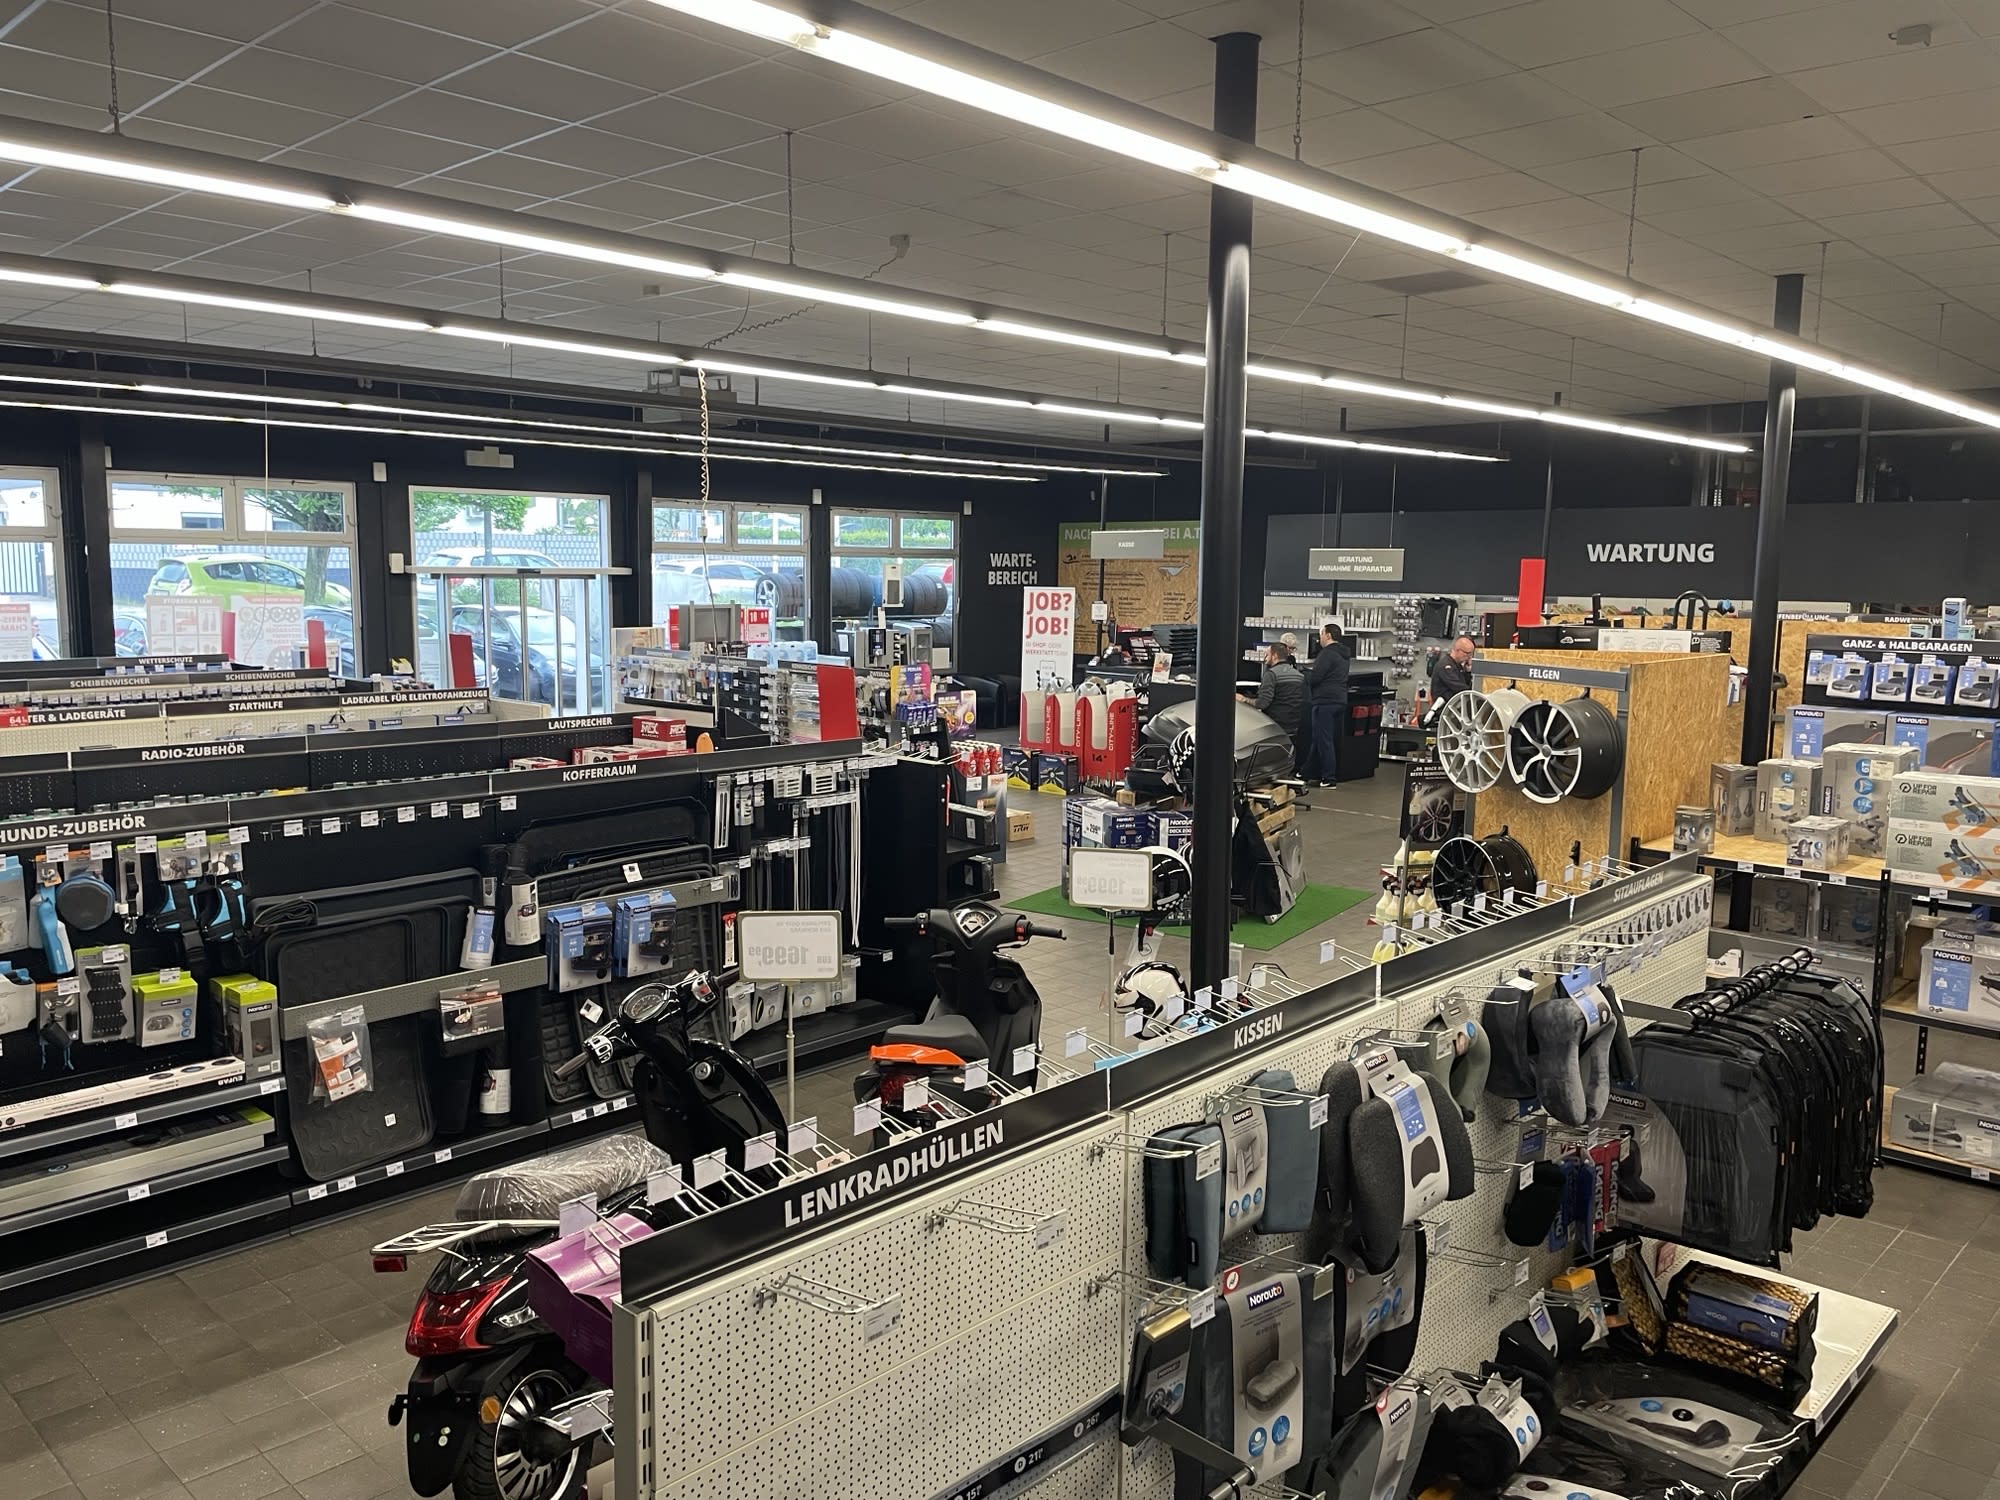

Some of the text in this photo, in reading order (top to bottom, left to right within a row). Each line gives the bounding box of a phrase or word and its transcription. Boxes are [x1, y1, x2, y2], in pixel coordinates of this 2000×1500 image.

[1587, 543, 1715, 563] WARTUNG
[990, 553, 1037, 568] WARTE-
[1354, 565, 1393, 573] REPARATUR
[988, 571, 1038, 585] BEREICH
[1026, 592, 1073, 615] JOB?
[1025, 616, 1069, 639] JOB!
[1842, 639, 1973, 652] GANZ- & HALBGARAGEN
[138, 656, 193, 665] WETTERSCHUTZ
[225, 671, 296, 681] SCHEIBENWISCHER
[1529, 668, 1560, 680] FELGEN
[70, 677, 150, 688] SCHEIBENWISCHER
[341, 690, 488, 705] LADEKABEL FÜR ELEKTROFAHRZEUGE
[228, 700, 284, 712] STARTHILFE
[48, 714, 57, 722] &
[60, 708, 126, 722] LADEGERÄTE
[1897, 717, 1928, 726] Norauto
[548, 717, 613, 730] LAUTSPRECHER
[142, 744, 245, 761] RADIO-ZUBEHÖR
[562, 764, 637, 782] KOFFERRAUM
[0, 815, 146, 843] HUNDE-ZUBEHÖR
[1614, 870, 1664, 902] SITZAUFLAGEN
[1934, 950, 1972, 962] Norauto
[1233, 1012, 1284, 1050] KISSEN
[1608, 1094, 1645, 1108] Norauto
[1234, 1108, 1252, 1123] Norauto
[784, 1118, 1005, 1228] LENKRADHÜLLEN
[1250, 1284, 1282, 1307] Norauto
